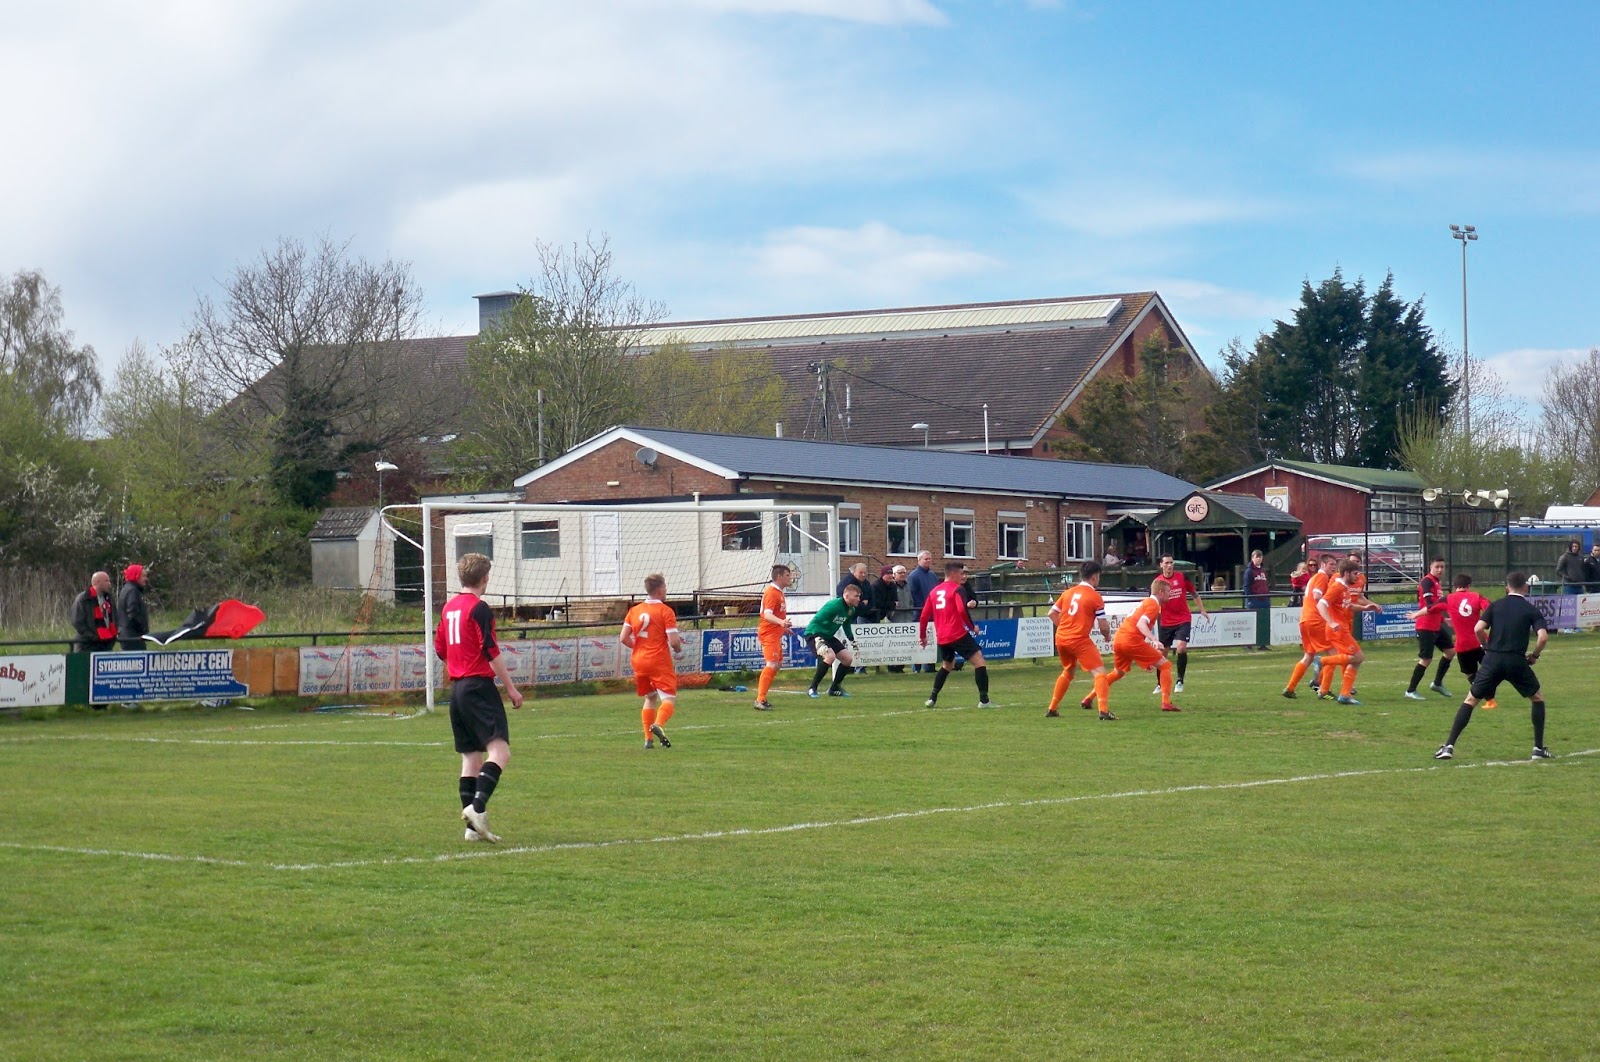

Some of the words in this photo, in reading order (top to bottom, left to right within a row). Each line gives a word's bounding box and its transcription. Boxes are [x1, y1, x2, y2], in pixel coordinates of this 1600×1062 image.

[935, 589, 947, 610] 3
[1068, 593, 1082, 616] 5
[1458, 598, 1473, 617] 6
[446, 609, 461, 645] 11
[637, 612, 650, 638] 2
[855, 625, 917, 637] CROCKERS
[733, 634, 789, 653] SYDENS
[985, 638, 1011, 649] Interiors
[98, 659, 144, 672] SYDENHAMS
[148, 653, 207, 671] LANDSCAPE
